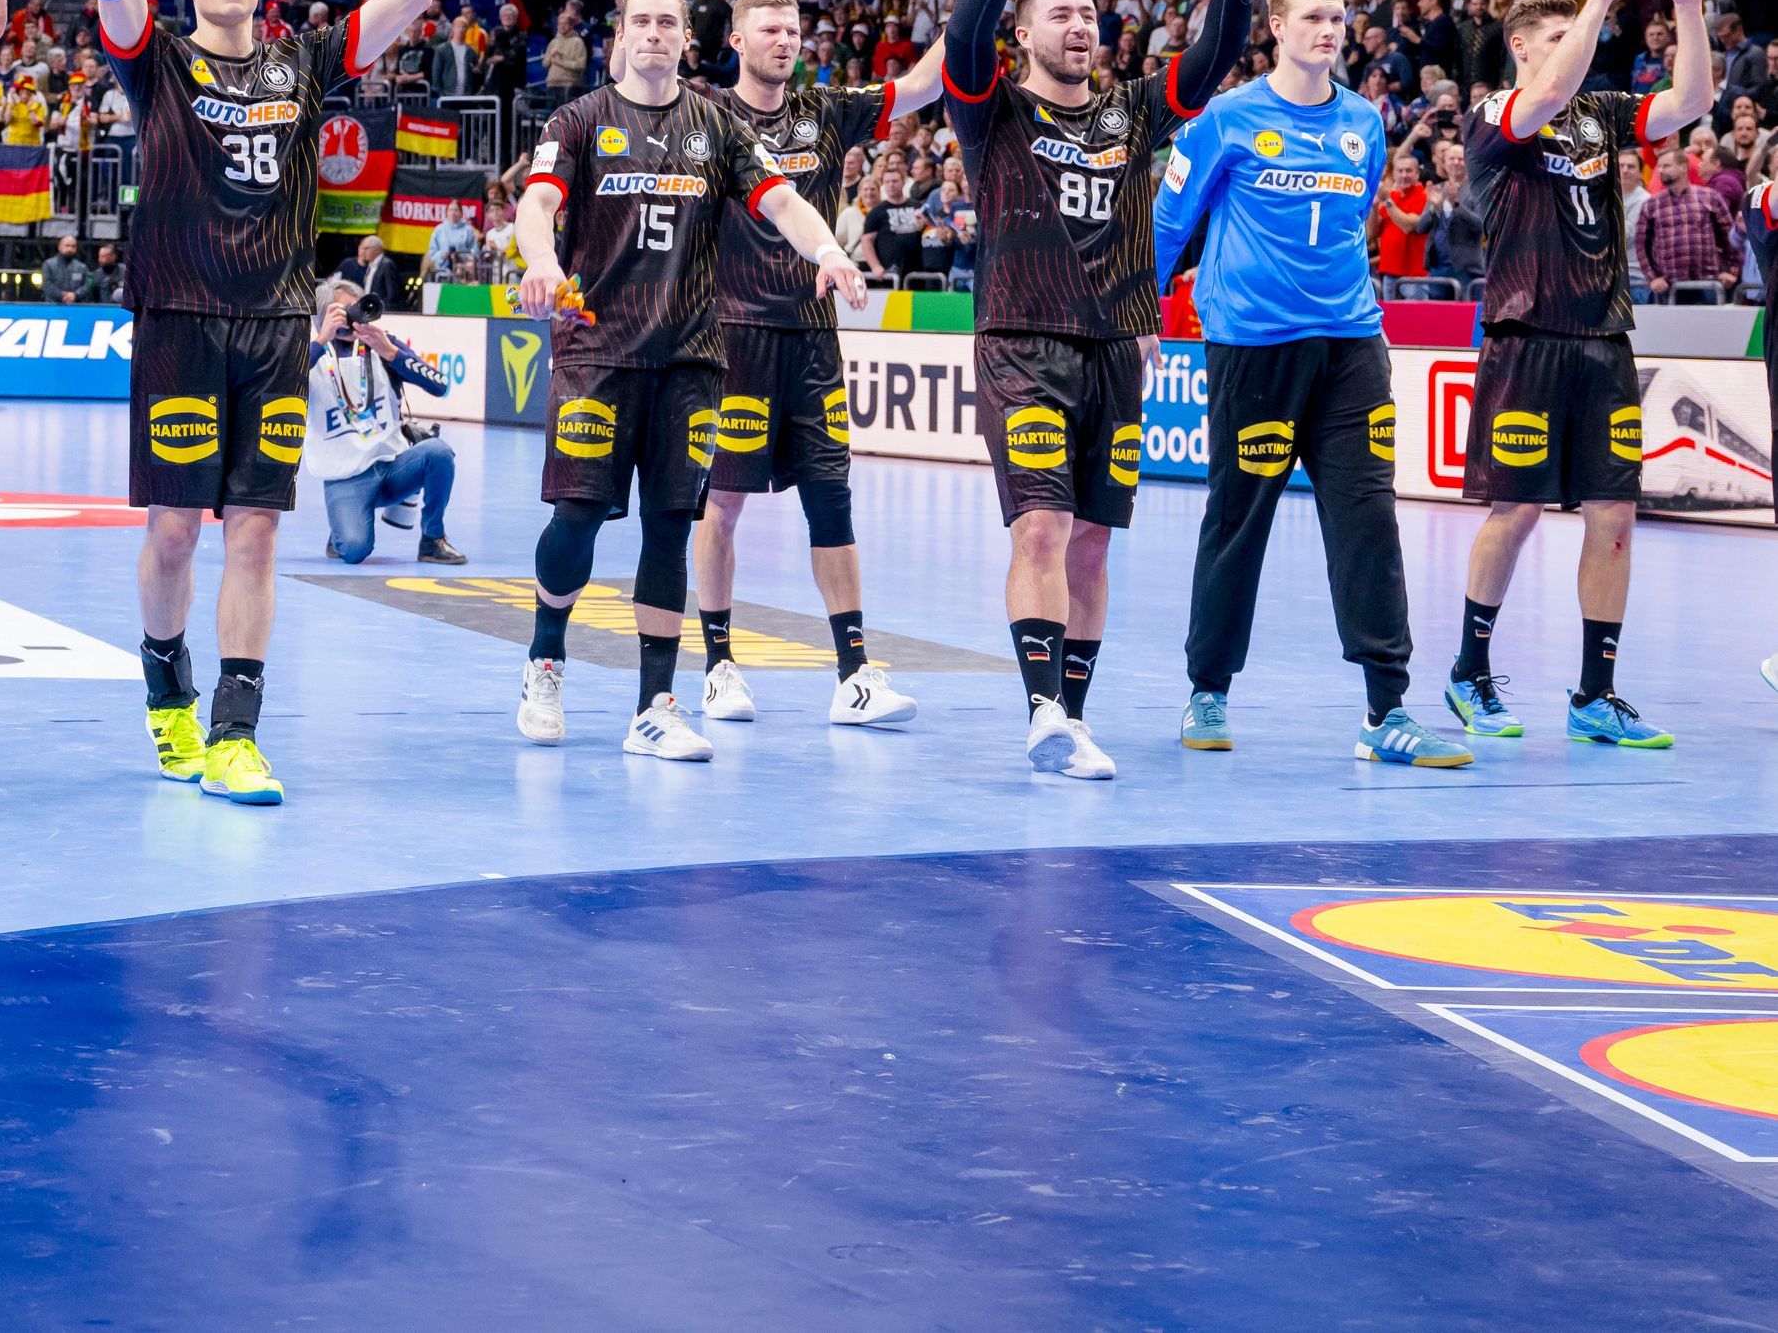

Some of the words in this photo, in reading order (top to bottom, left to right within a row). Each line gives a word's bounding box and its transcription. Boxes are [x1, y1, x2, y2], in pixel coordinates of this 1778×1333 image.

[196, 99, 298, 124] AUTOHERO
[223, 134, 280, 183] 38
[600, 176, 706, 194] AUTOHERO
[1260, 171, 1364, 194] AUTOHERO
[1060, 171, 1114, 220] 80
[1570, 185, 1596, 225] 11
[637, 203, 676, 252] 15
[1309, 201, 1321, 246] 1
[151, 421, 218, 438] HARTING
[557, 421, 614, 438] HARTING
[1007, 432, 1065, 446] HARTING
[1493, 431, 1548, 446] HARTING
[1239, 441, 1293, 456] HARTING
